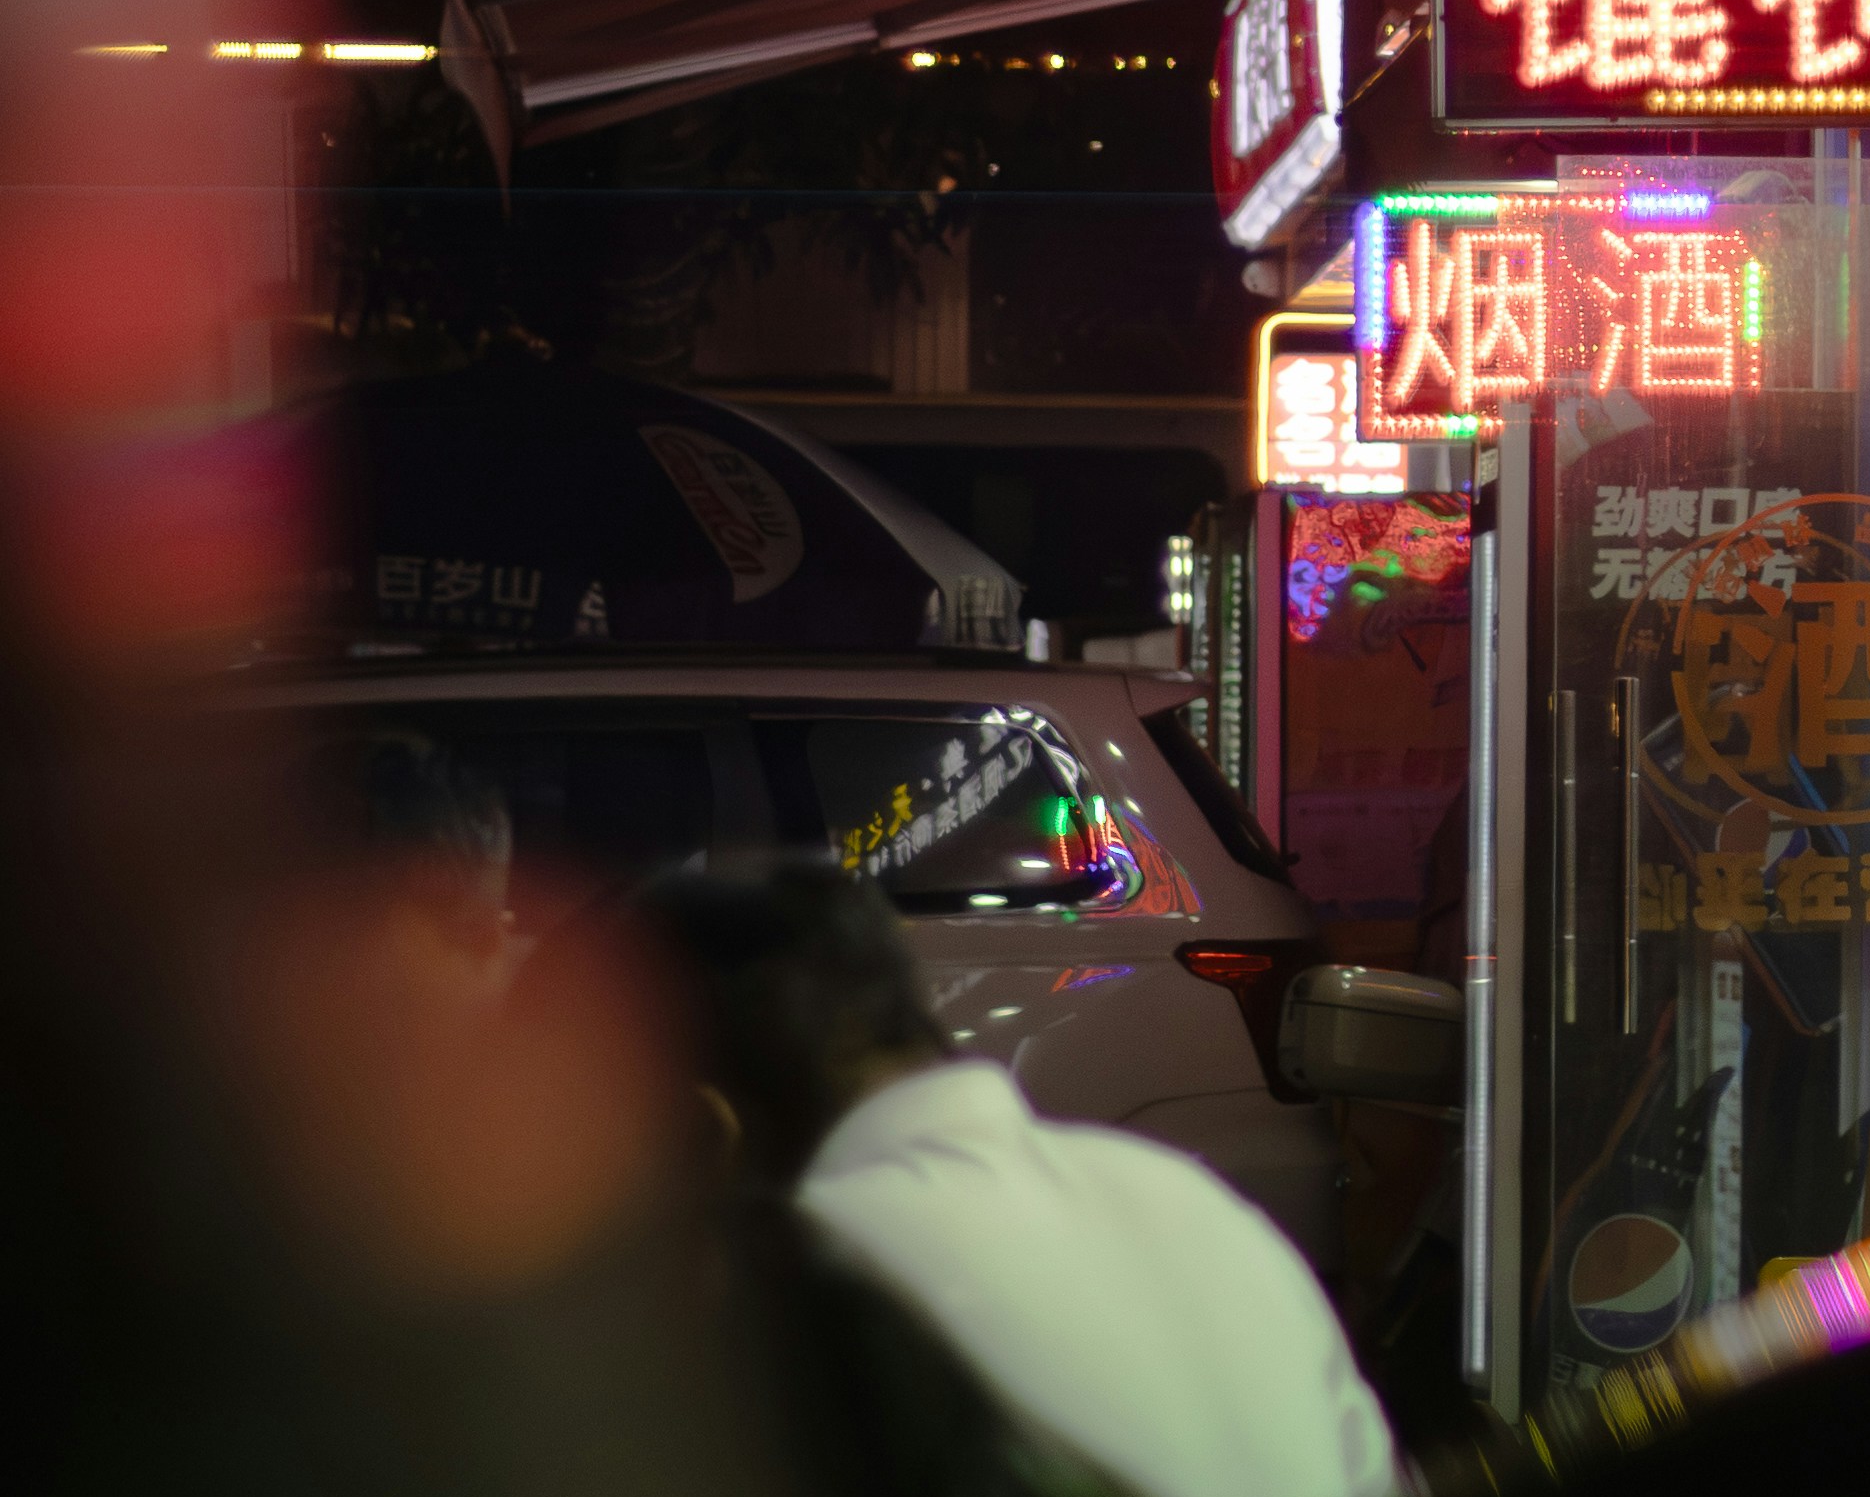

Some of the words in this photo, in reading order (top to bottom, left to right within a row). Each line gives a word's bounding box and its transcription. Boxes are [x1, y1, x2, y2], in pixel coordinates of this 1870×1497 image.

[1387, 219, 1738, 410] 烟酒
[376, 554, 542, 610] 百岁山
